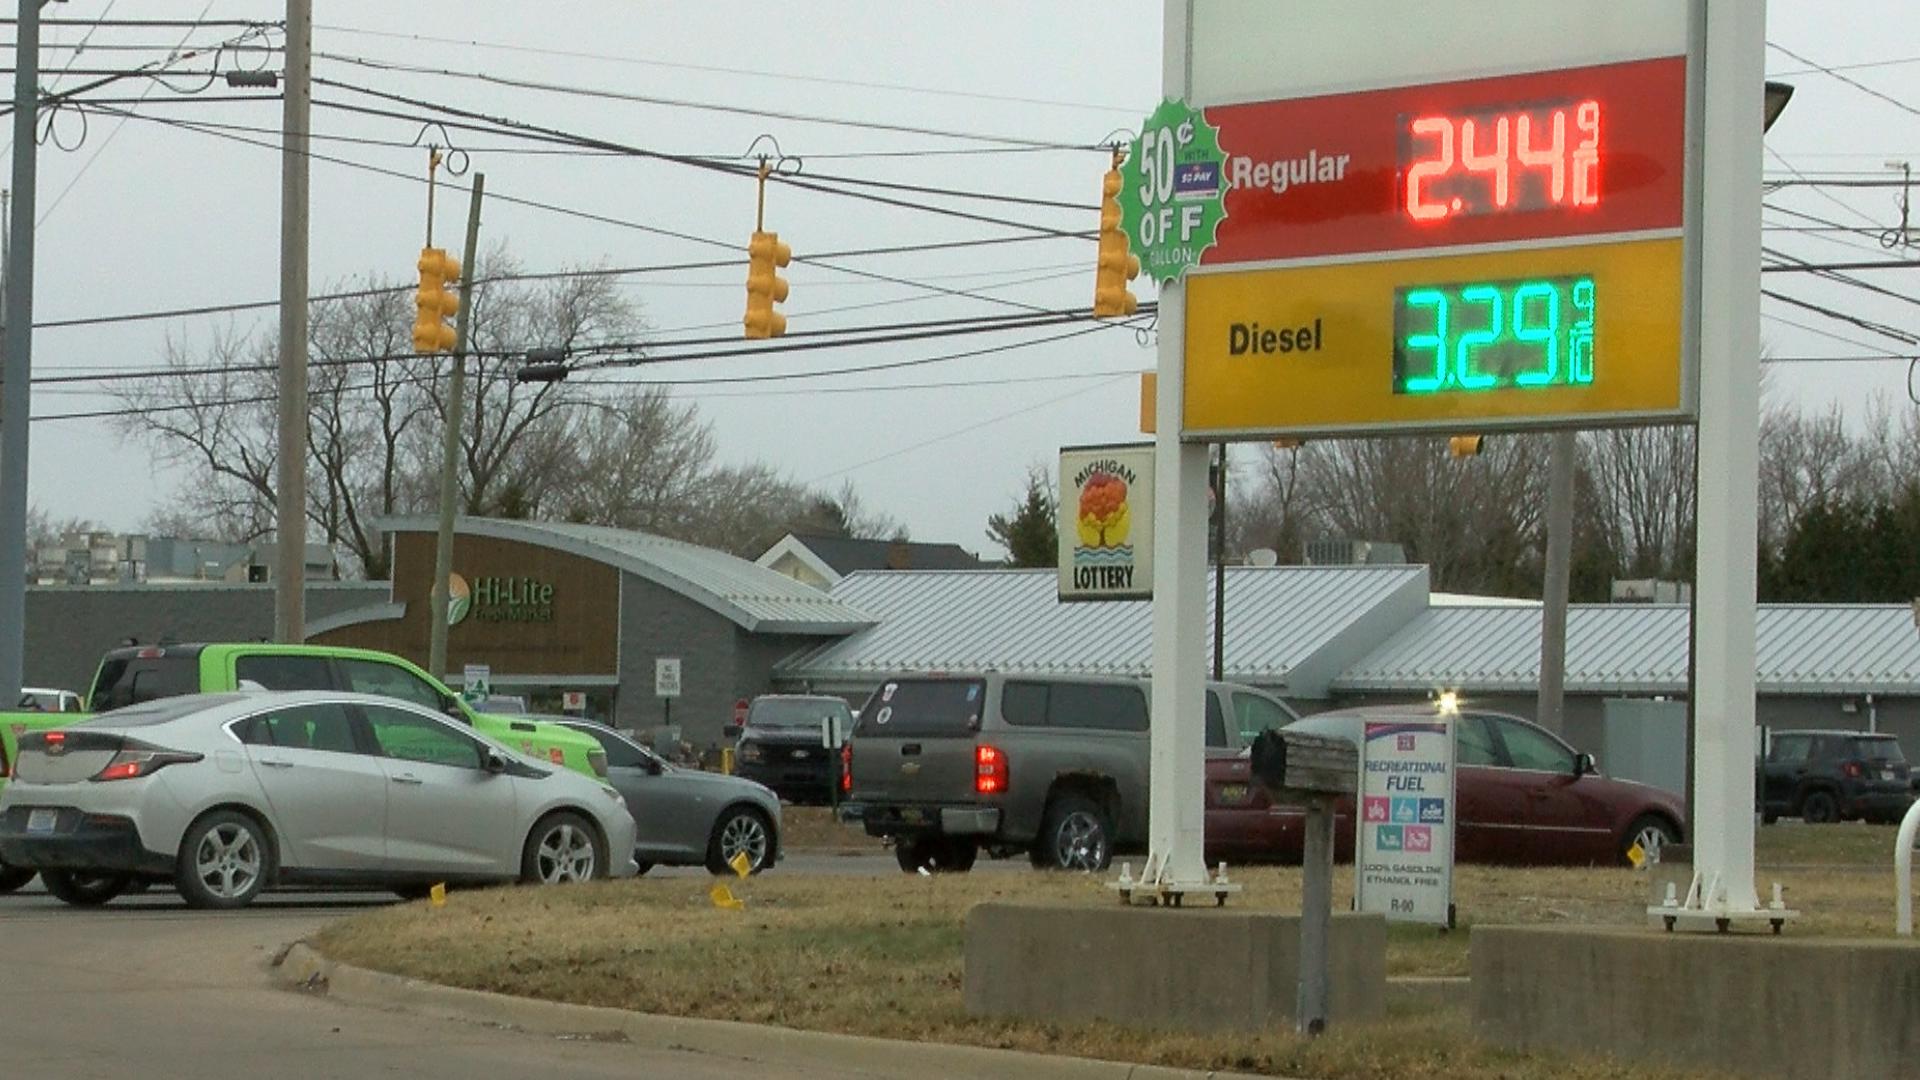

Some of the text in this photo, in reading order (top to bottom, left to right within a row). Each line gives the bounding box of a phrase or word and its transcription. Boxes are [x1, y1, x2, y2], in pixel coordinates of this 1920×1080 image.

[1577, 101, 1600, 149] 9
[1231, 150, 1350, 194] Regular
[1407, 111, 1566, 220] 2.44
[1140, 204, 1203, 247] OFF
[1573, 279, 1595, 328] 9
[1229, 318, 1322, 356] Diesel
[1406, 282, 1559, 391] 3.29
[1074, 459, 1136, 488] MICHIGAN
[474, 577, 553, 605] Hi-Lite
[1074, 565, 1134, 589] LOTTERY
[1365, 760, 1446, 773] RECREATIONAL
[1386, 775, 1424, 791] FUEL
